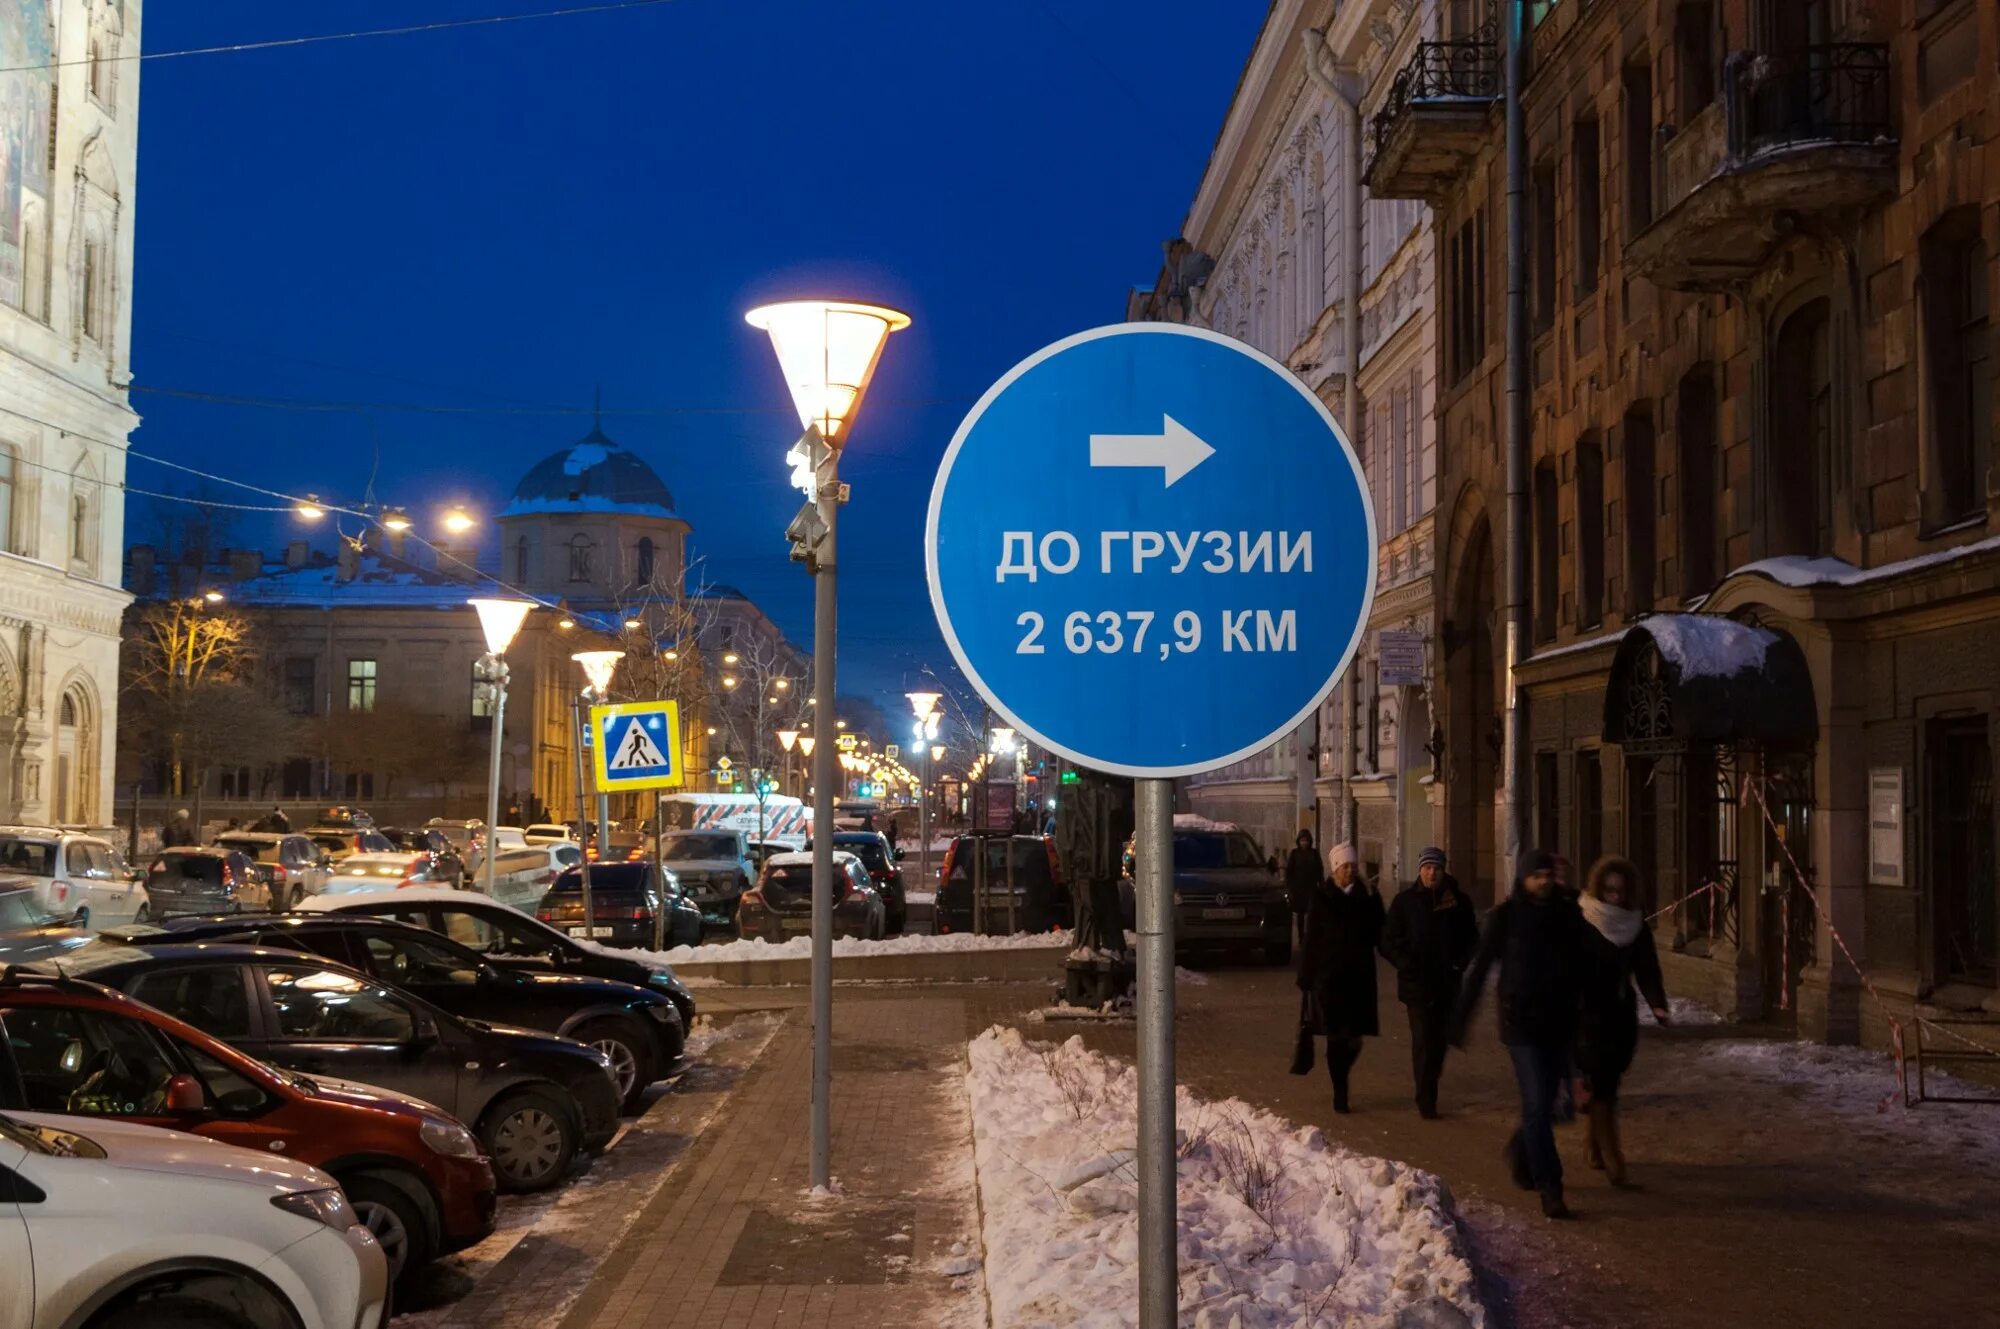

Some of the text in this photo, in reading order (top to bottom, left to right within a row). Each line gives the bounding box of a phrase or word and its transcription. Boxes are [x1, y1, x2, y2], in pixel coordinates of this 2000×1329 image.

[996, 530, 1313, 583] ДО ГРУЗИИ
[1016, 609, 1297, 661] 2 637,9 КМ
